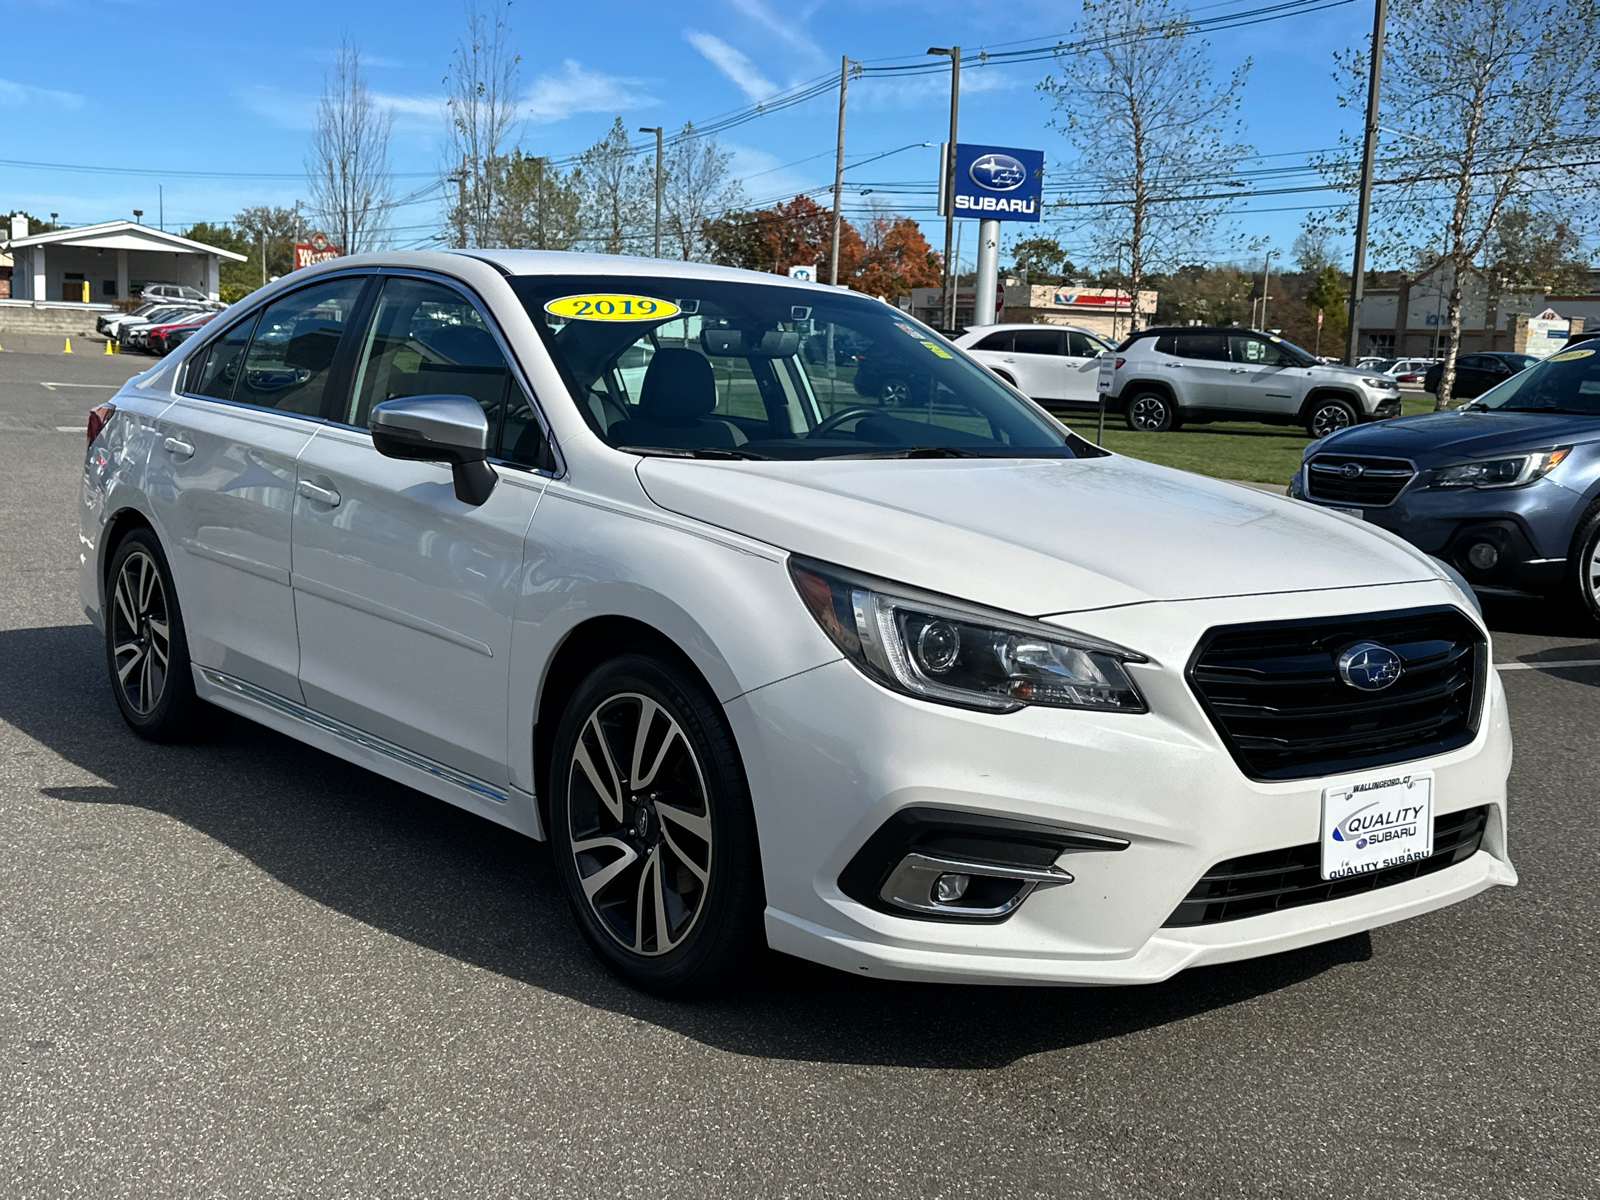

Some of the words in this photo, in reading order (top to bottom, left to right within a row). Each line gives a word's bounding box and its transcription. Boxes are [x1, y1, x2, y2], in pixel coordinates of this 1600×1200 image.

[955, 195, 1035, 213] SUBARU
[573, 300, 658, 316] 2019
[1348, 805, 1424, 832] QUALITY
[1368, 826, 1417, 845] SUBARU
[1329, 861, 1379, 880] QUALITY
[1382, 849, 1430, 868] SUBARU
